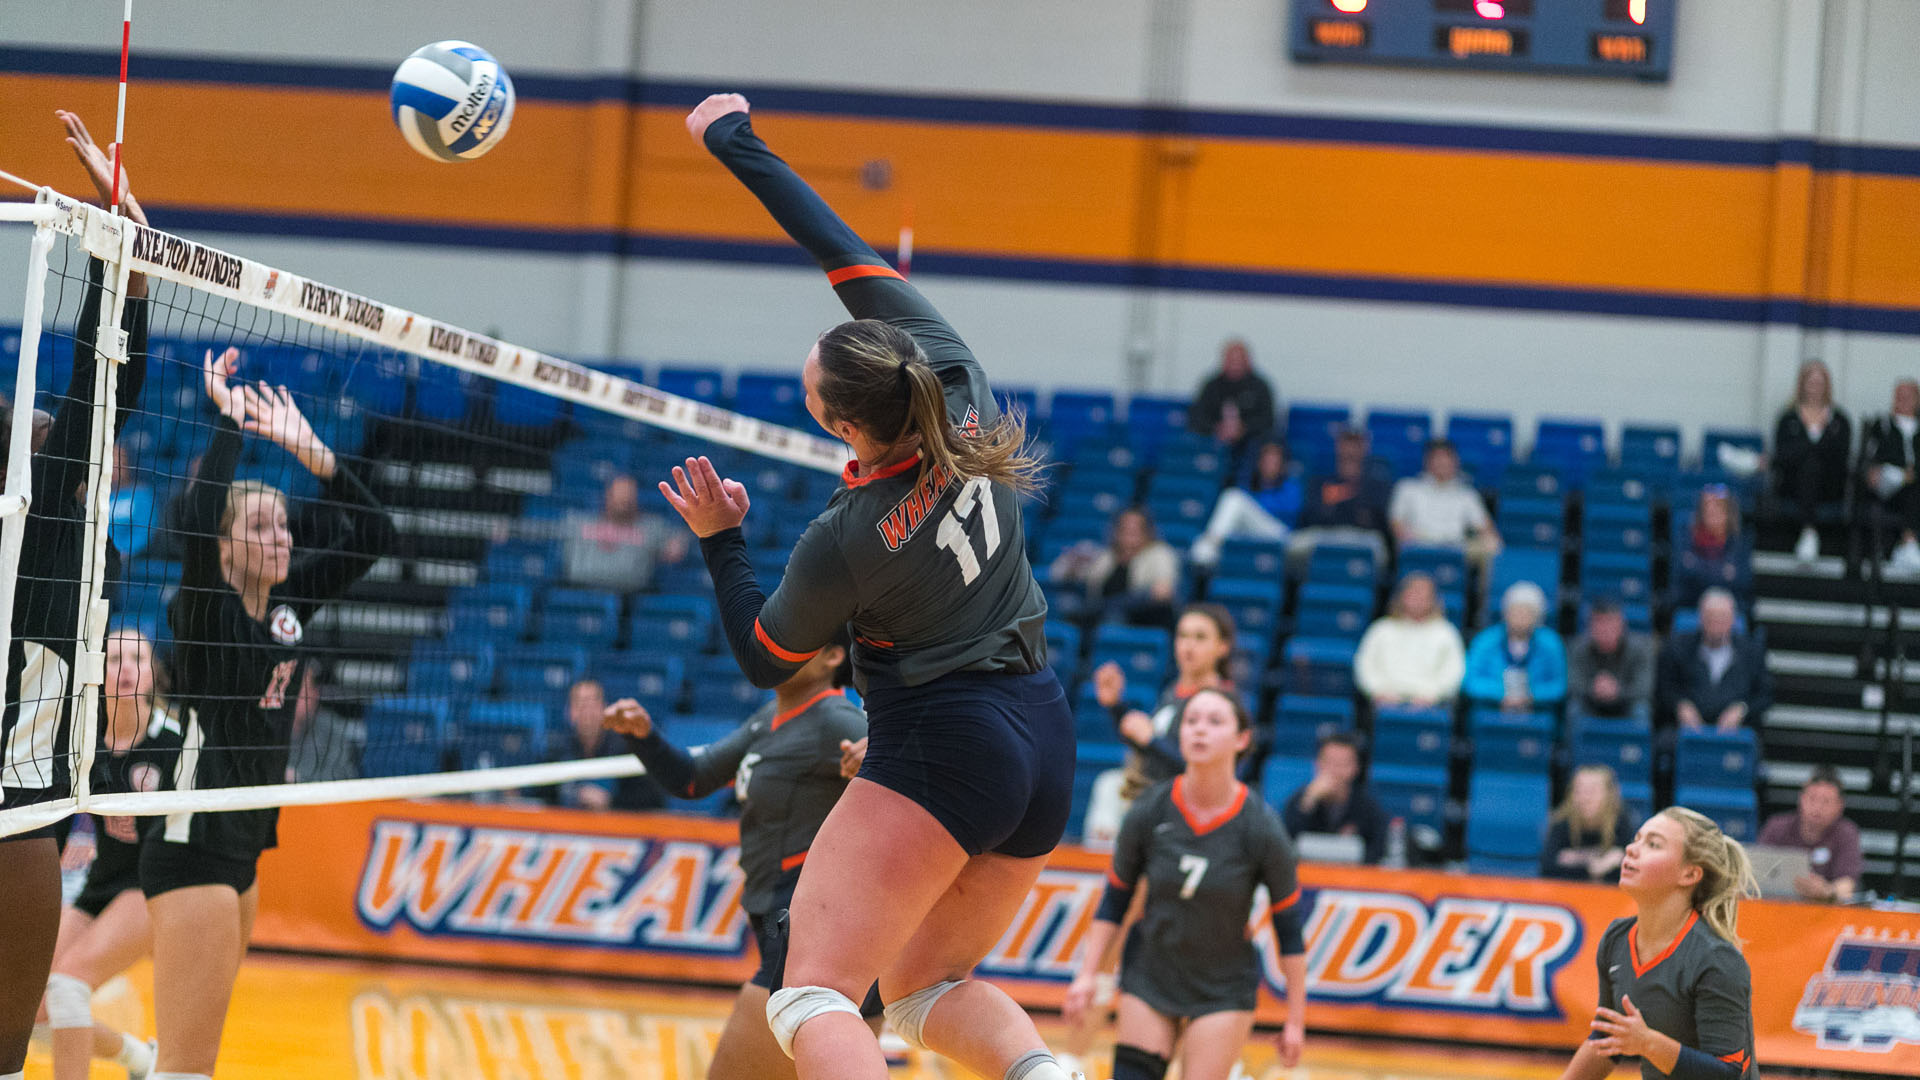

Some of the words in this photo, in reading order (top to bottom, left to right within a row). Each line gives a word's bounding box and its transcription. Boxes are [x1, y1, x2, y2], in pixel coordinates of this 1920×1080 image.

[450, 73, 493, 133] molten
[936, 475, 1001, 587] 17
[1179, 854, 1209, 899] 7
